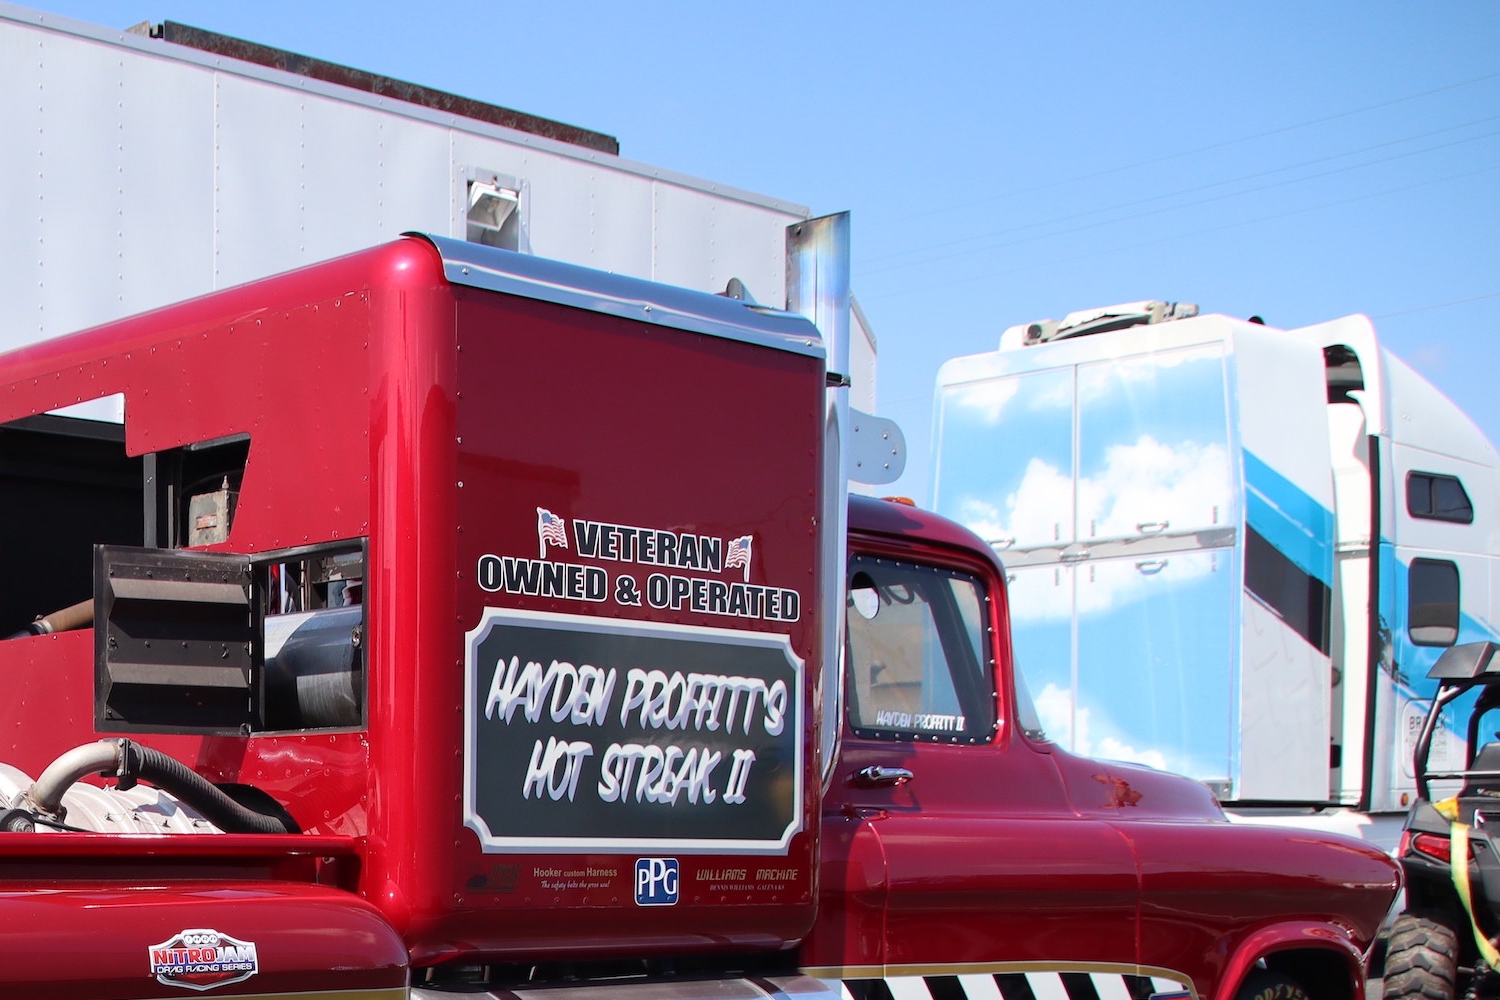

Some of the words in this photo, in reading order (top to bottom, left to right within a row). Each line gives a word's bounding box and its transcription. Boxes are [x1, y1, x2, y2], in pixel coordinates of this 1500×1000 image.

[573, 519, 722, 573] VETERAN
[477, 555, 608, 601] OWNED
[614, 574, 642, 606] &
[648, 573, 800, 622] OPERATED
[484, 655, 617, 727] HAYDEN
[620, 667, 787, 737] PROFFITT'S
[876, 710, 911, 728] HAYDEN
[956, 716, 965, 731] II
[523, 736, 594, 803] HOT
[597, 743, 721, 806] STREAK
[723, 749, 756, 804] II
[533, 867, 562, 877] Hooker
[586, 867, 618, 877] Harness
[638, 858, 677, 898] PPG
[696, 869, 747, 880] WILLIAMS
[756, 869, 799, 880] MACHINE
[157, 965, 183, 974] DRAG
[186, 964, 219, 973] RACING
[222, 963, 252, 971] SERIES
